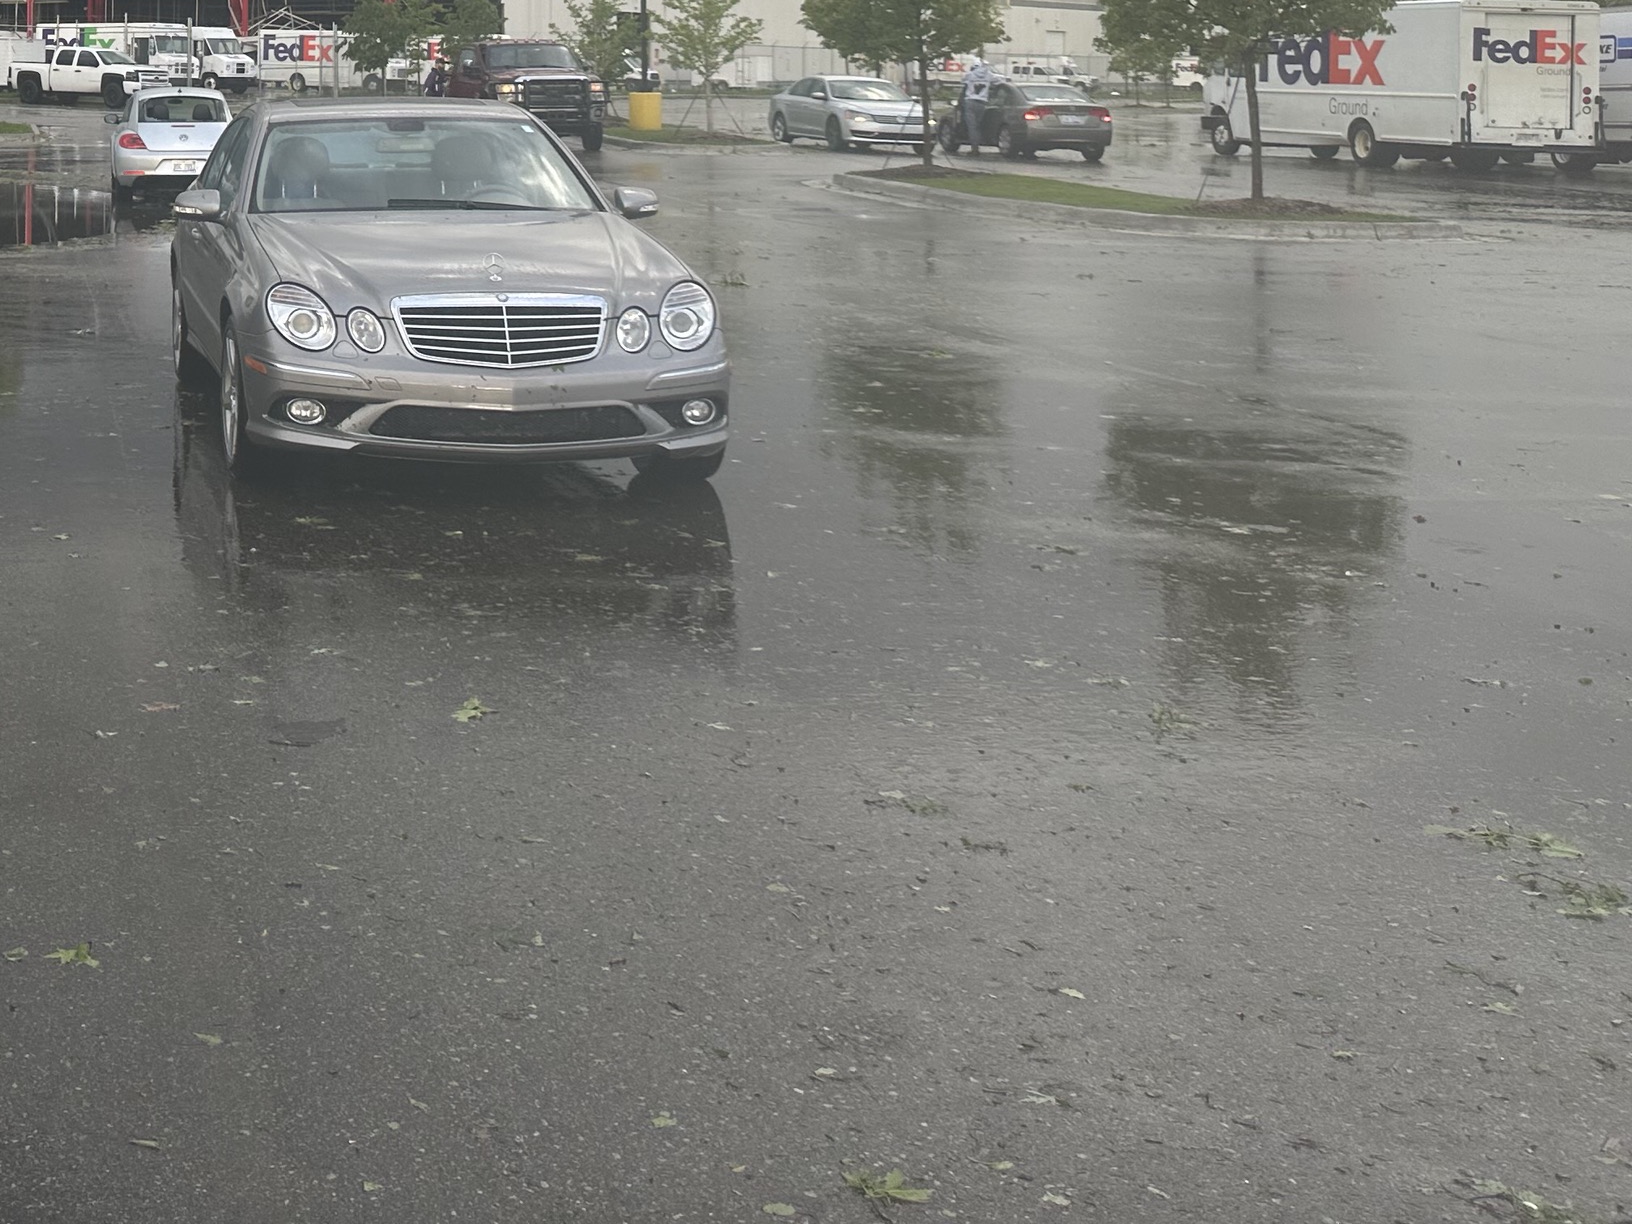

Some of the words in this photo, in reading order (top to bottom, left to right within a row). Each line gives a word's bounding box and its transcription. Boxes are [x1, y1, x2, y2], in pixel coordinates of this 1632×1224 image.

[263, 34, 333, 62] FedEx
[1473, 27, 1587, 65] FedEx
[1329, 97, 1368, 115] Ground
